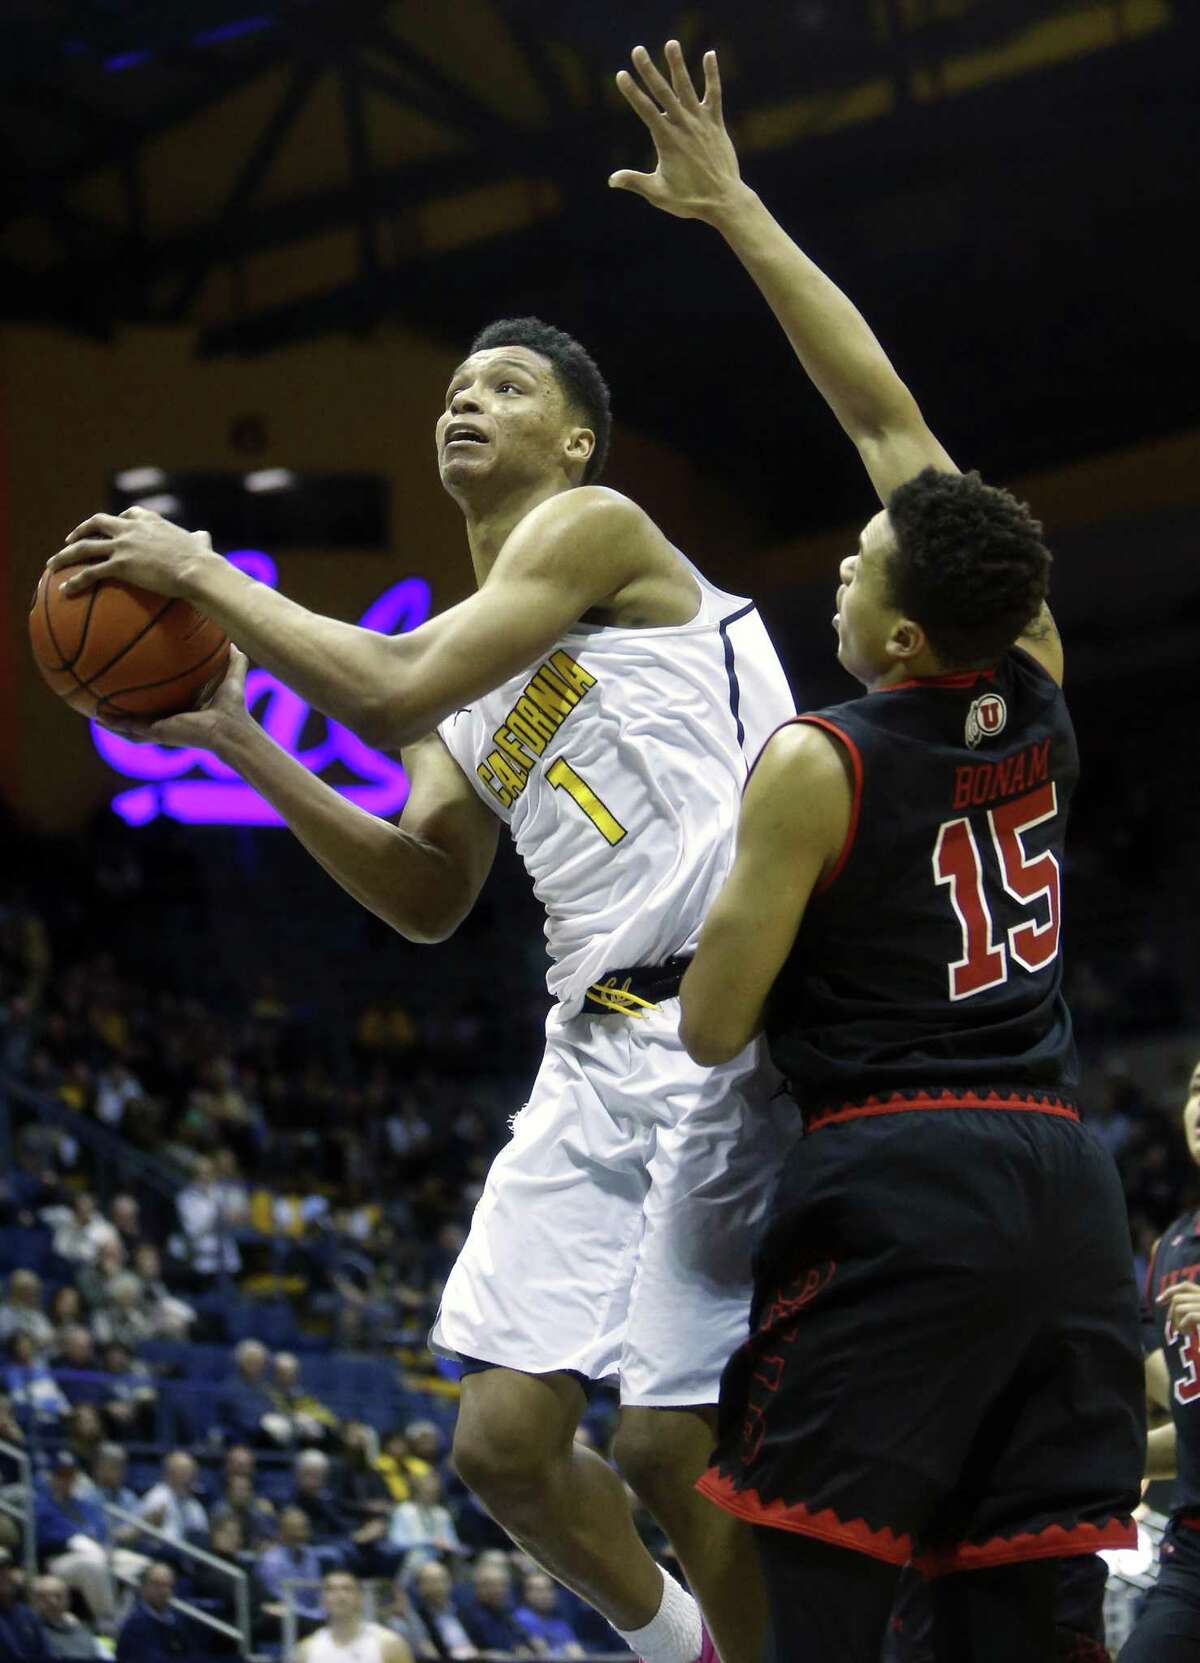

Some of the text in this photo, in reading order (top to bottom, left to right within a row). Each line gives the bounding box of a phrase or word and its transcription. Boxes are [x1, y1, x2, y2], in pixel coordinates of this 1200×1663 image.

[476, 648, 598, 810] CAFORNIA
[952, 736, 1051, 810] BONAM
[544, 755, 629, 847] 1
[931, 780, 1061, 1002] 15
